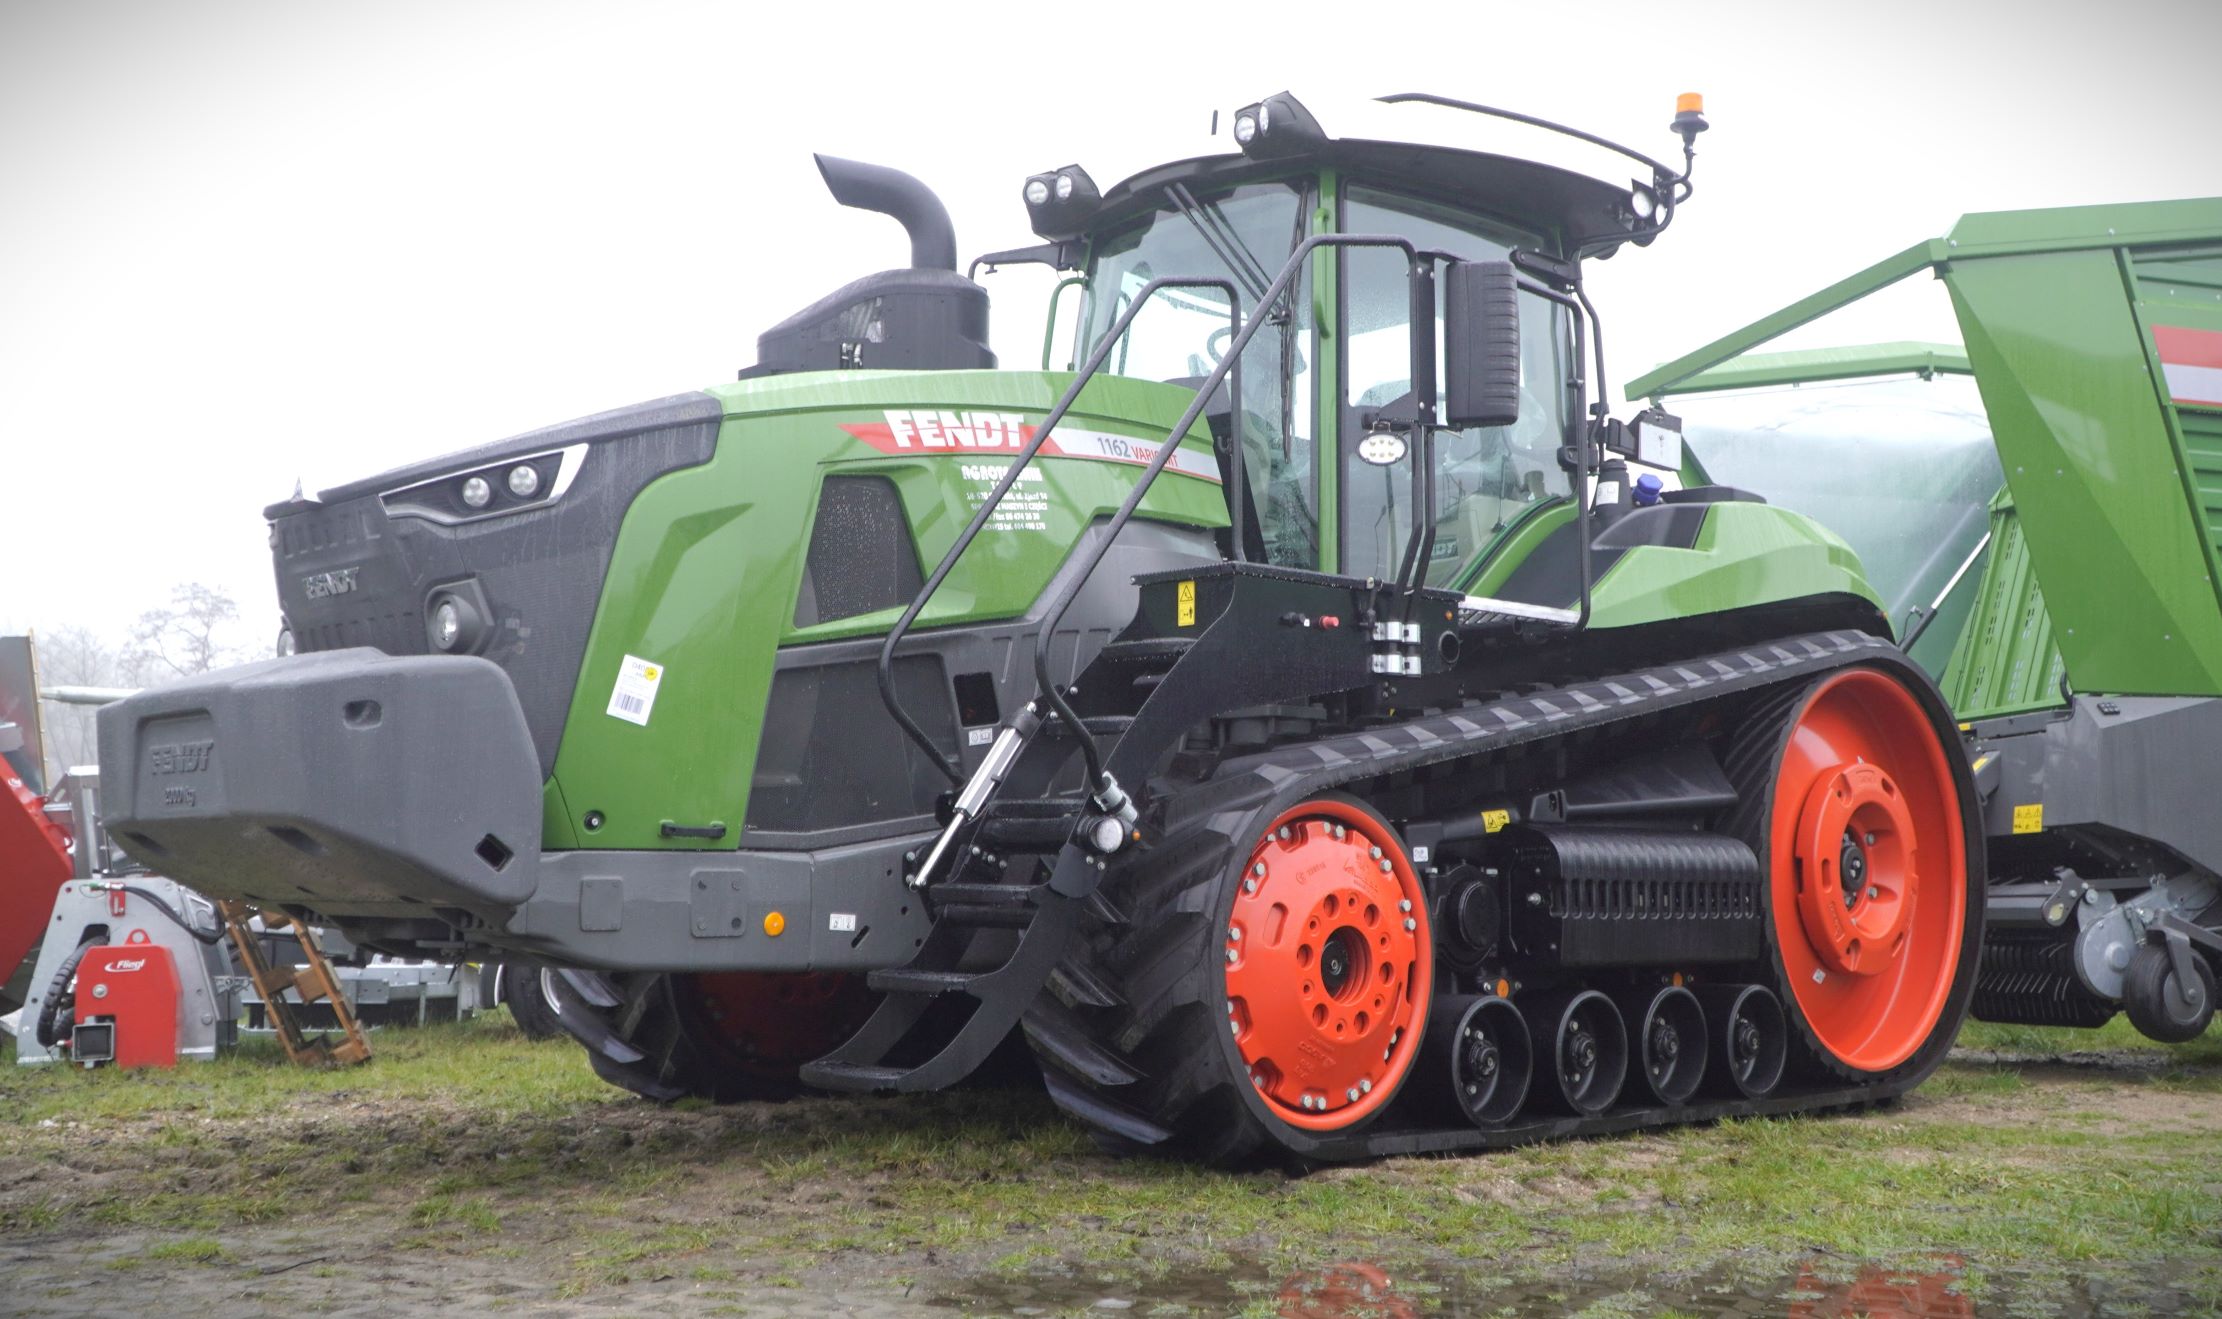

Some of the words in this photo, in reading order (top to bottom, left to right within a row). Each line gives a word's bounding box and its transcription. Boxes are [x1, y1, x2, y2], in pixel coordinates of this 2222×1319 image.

[883, 410, 1025, 448] FENDT
[1097, 437, 1131, 458] 1162
[303, 566, 359, 600] FENDT
[150, 740, 214, 775] FENDT
